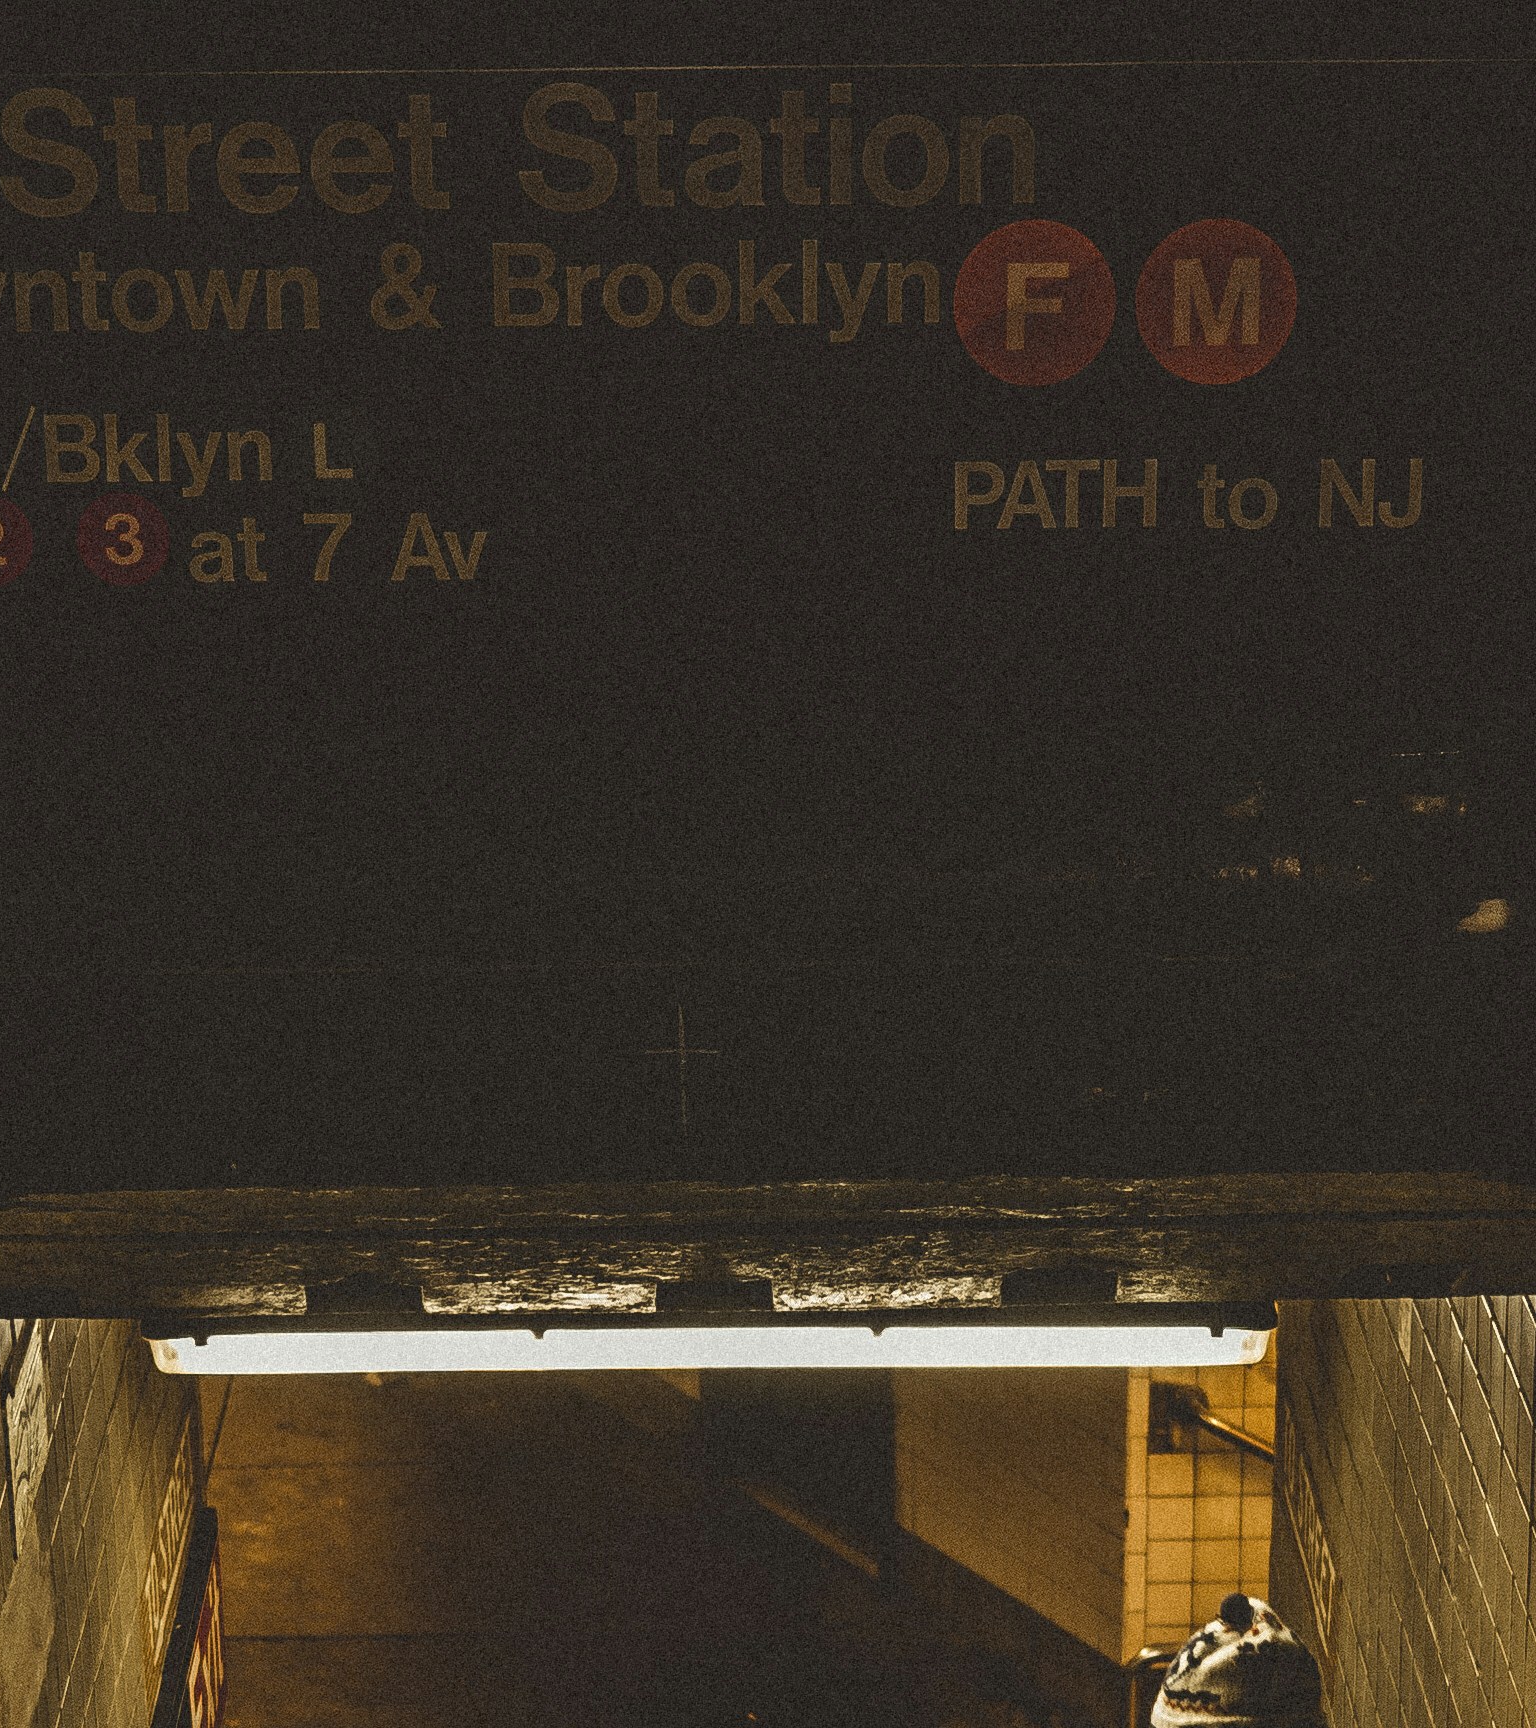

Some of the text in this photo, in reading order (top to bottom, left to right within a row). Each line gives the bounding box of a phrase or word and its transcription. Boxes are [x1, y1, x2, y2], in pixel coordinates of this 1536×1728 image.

[0, 87, 450, 218] Street
[517, 80, 1035, 211] Station
[370, 243, 441, 331] &
[492, 238, 941, 343] Brooklyn
[1005, 260, 1071, 352] F
[1172, 256, 1261, 348] M
[313, 423, 353, 479] L
[953, 458, 1423, 530] PATH to NJ
[105, 512, 143, 566] 3
[190, 517, 267, 584] at
[303, 512, 352, 582] 7
[392, 513, 487, 581] Av
